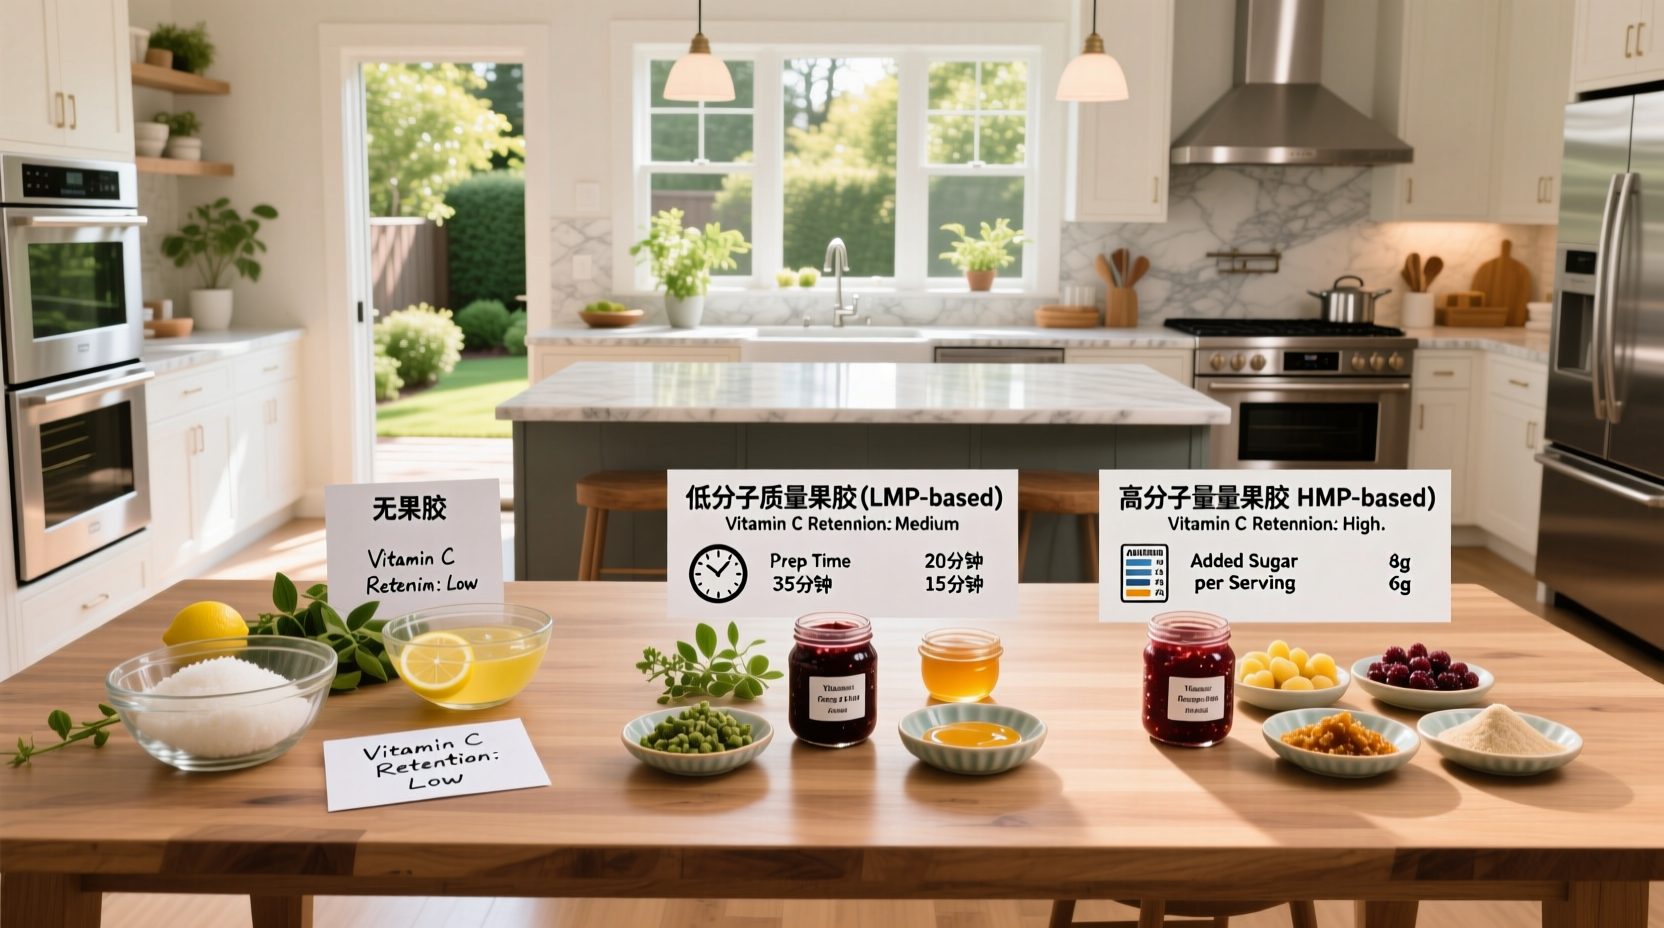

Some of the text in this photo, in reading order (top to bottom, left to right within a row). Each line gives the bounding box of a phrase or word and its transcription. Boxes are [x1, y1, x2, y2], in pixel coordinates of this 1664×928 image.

[373, 494, 446, 521] 无果胶
[1298, 486, 1435, 511] HMP-based)
[726, 516, 786, 530] Vitamin
[792, 516, 802, 530] C
[896, 516, 959, 530] Medium
[1168, 516, 1229, 531] Vitamin
[1235, 516, 1246, 530] C
[1344, 516, 1385, 535] High.
[368, 547, 455, 568] Vitamin C
[771, 553, 851, 572] Prep Time
[925, 551, 983, 570] 20分钟
[1190, 553, 1298, 572] Added Sugar
[1389, 554, 1410, 573] 8g
[447, 574, 478, 591] Low
[773, 575, 832, 594] 35分钟
[926, 575, 983, 594] 15分钟
[1195, 575, 1295, 594] per Serving
[1389, 576, 1411, 595] 6g
[363, 733, 482, 761] Vitamin C
[376, 752, 499, 778] Retention:
[409, 774, 463, 789] Low
